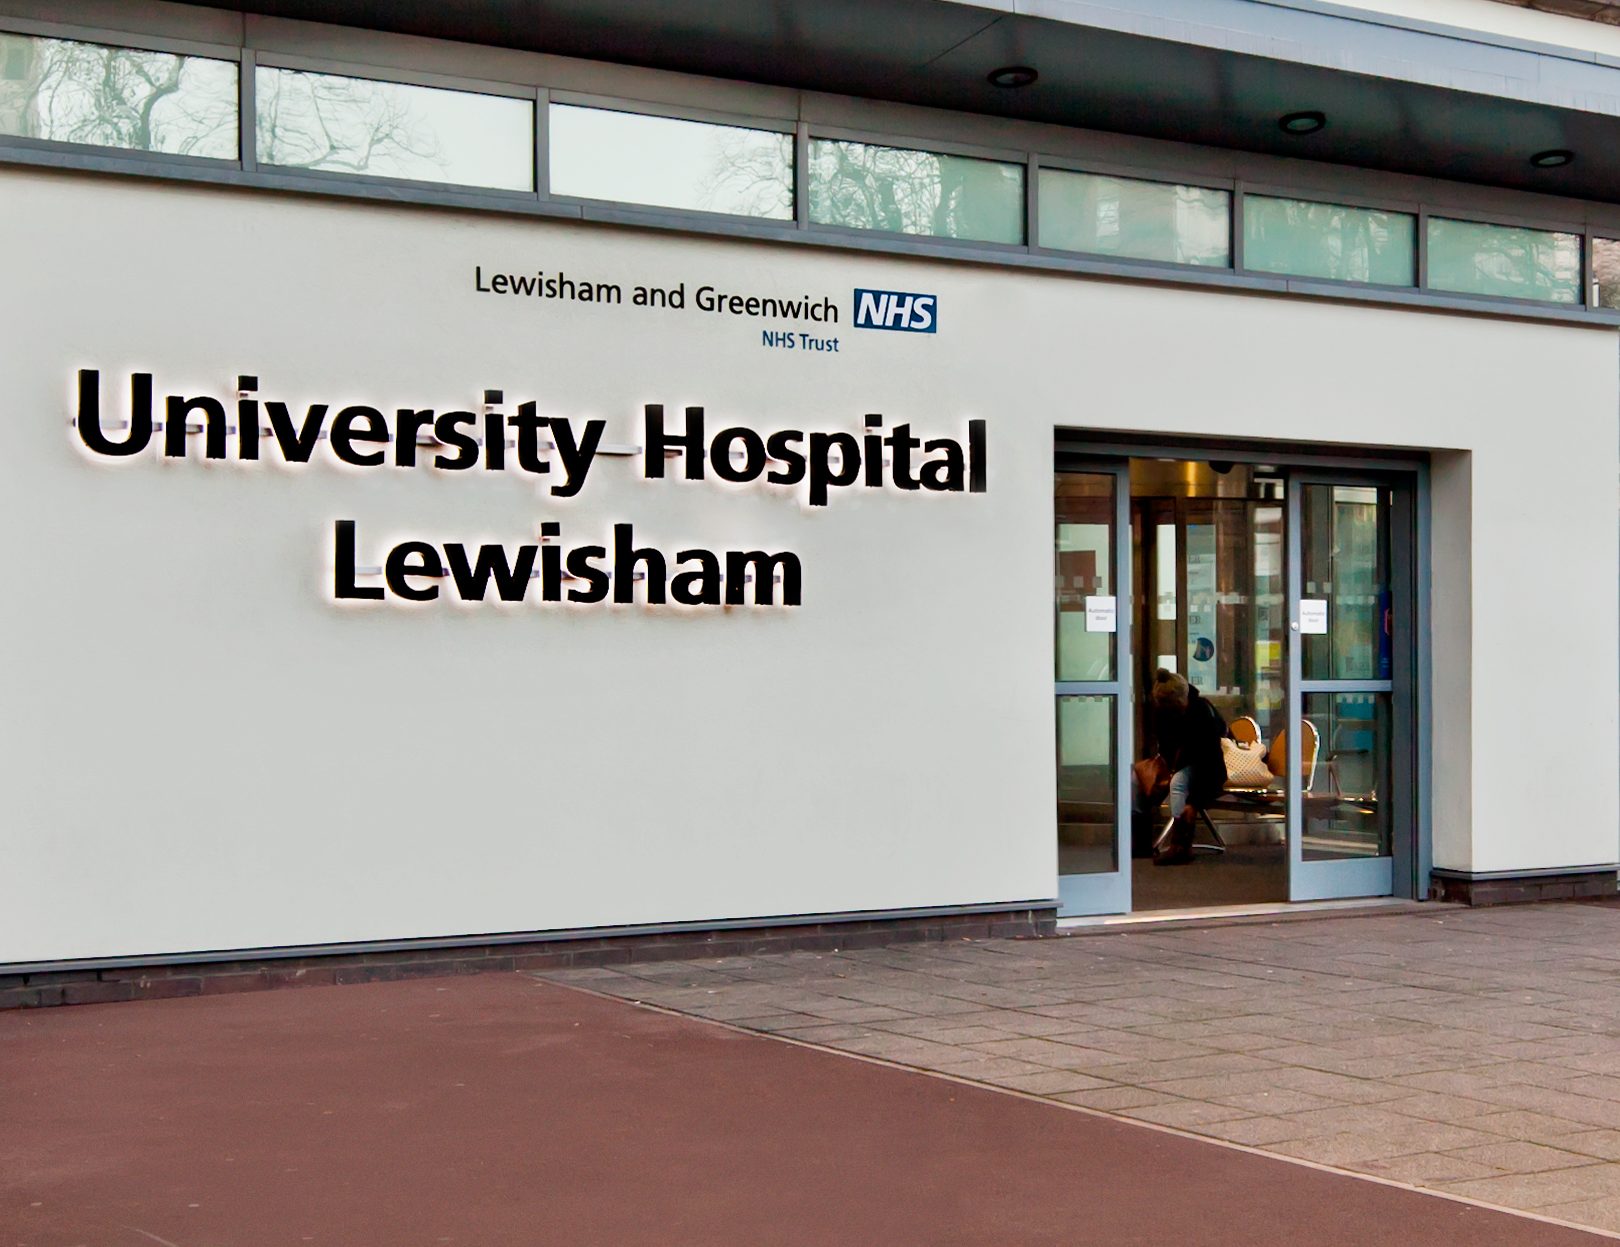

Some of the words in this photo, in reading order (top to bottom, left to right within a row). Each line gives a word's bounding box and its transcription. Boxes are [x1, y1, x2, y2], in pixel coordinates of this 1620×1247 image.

[475, 265, 622, 305] Lewisham
[632, 283, 685, 309] and
[696, 286, 839, 323] Greenwich
[854, 289, 937, 333] NHS
[763, 330, 795, 349] NHS
[799, 333, 839, 352] Trust
[77, 368, 606, 497] University
[645, 404, 986, 507] Hospital
[334, 519, 801, 606] Lewisham
